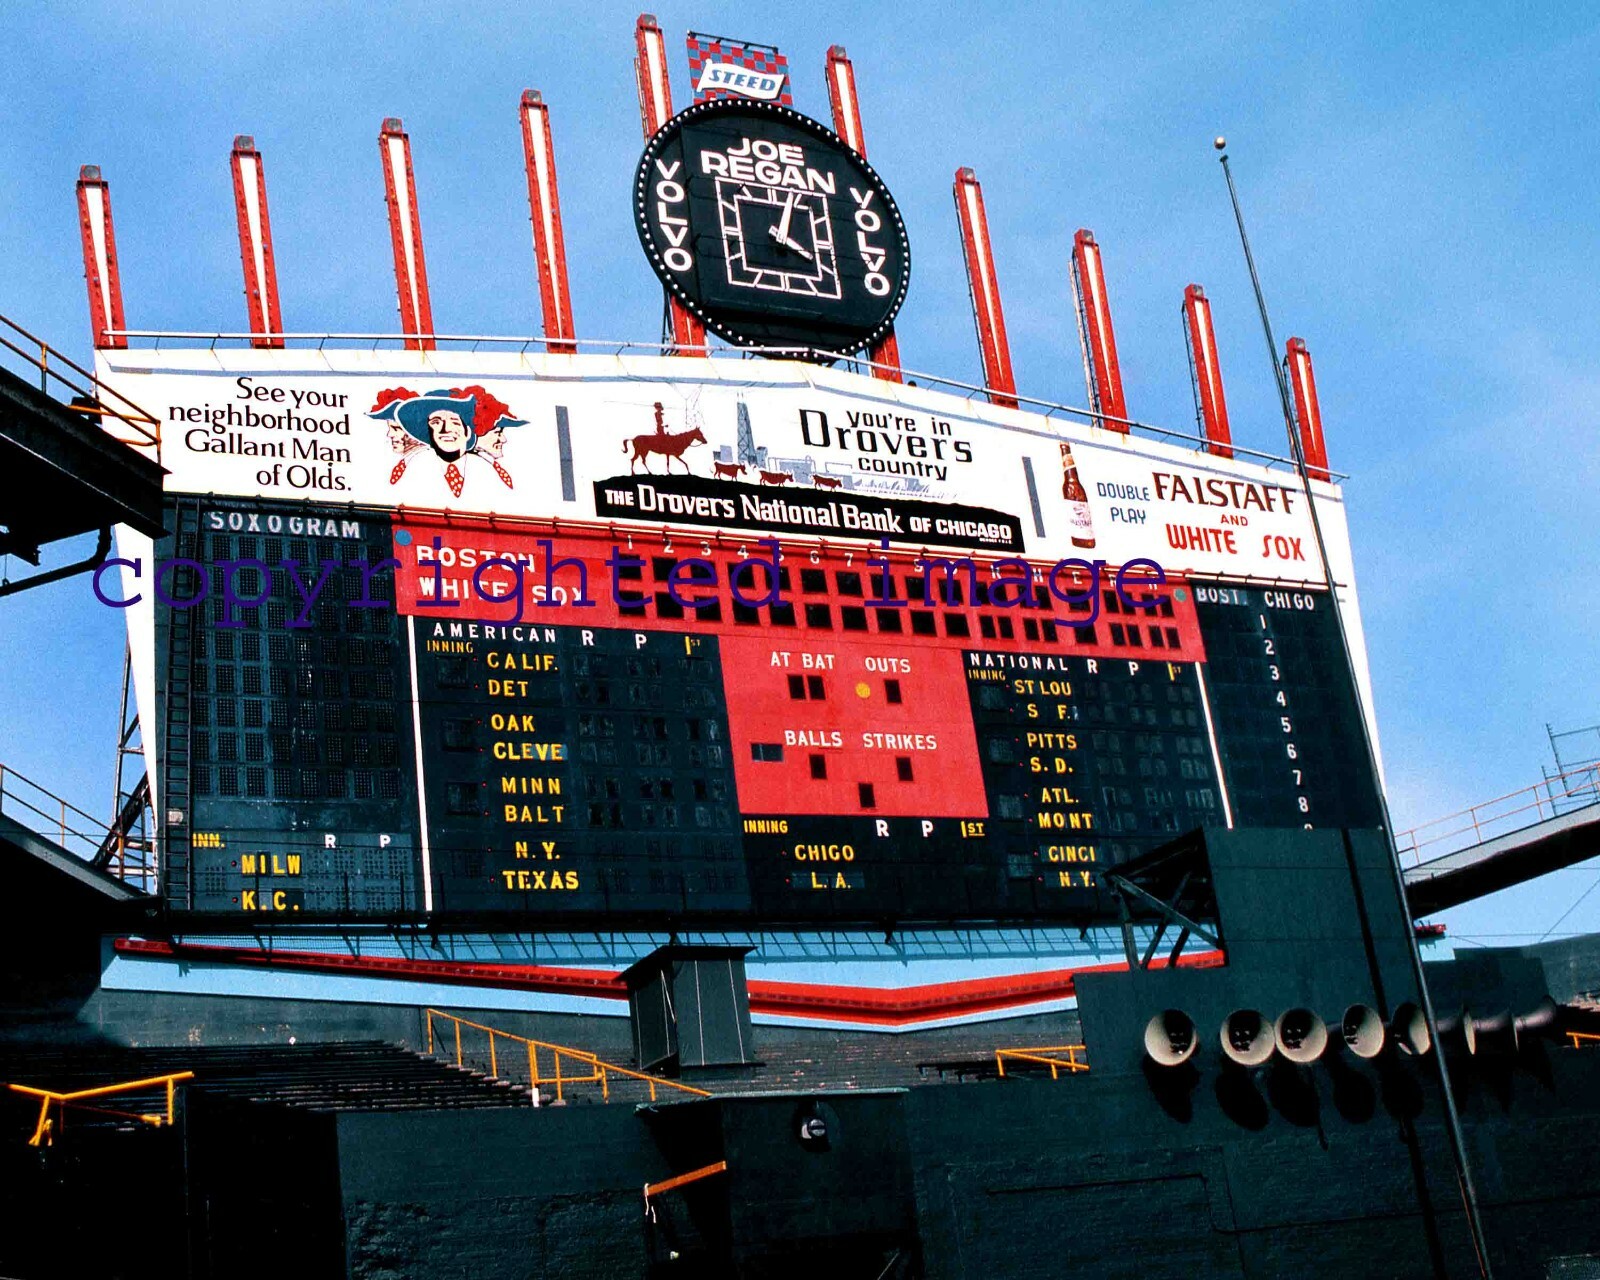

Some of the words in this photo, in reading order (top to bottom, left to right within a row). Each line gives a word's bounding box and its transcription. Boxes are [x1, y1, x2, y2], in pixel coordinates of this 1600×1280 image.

[708, 68, 776, 92] STEED
[727, 138, 805, 166] JOE
[701, 150, 836, 194] REGAN
[655, 159, 692, 271] VOLVO
[850, 187, 890, 296] VOLVO
[236, 377, 285, 402] See
[290, 389, 348, 409] your
[169, 403, 351, 435] neighborhood
[846, 411, 917, 432] you're
[931, 417, 952, 436] in
[799, 409, 973, 463] Drovers
[185, 429, 286, 458] Gallant
[292, 438, 351, 463] Man
[256, 464, 282, 486] of
[286, 463, 352, 491] Olds.
[858, 457, 948, 481] country
[1097, 482, 1150, 502] DOUBLE
[1152, 471, 1297, 514] FALSTAFF
[604, 489, 635, 506] THE
[637, 484, 736, 519] Drovers
[740, 493, 840, 528] National
[840, 504, 905, 533] Bank
[909, 516, 932, 533] OF
[936, 519, 1013, 540] CHICAGO
[1110, 507, 1147, 525] PLAY
[1220, 514, 1249, 527] AND
[1166, 524, 1238, 554] WHITE
[1262, 535, 1306, 562] SOX
[416, 545, 536, 573] BOSTON
[627, 534, 633, 550] 1
[663, 539, 674, 554] 2
[701, 541, 712, 556] 3
[737, 545, 749, 560] 4
[809, 550, 820, 565] 6
[844, 552, 854, 568] 7
[1033, 568, 1044, 583] H
[1260, 614, 1266, 629] 1
[433, 622, 556, 643] AMERICAN
[582, 630, 594, 646] R
[635, 633, 647, 649] P
[426, 639, 474, 653] INNING
[1264, 640, 1275, 655] 2
[487, 652, 559, 671] CALIF.
[770, 651, 791, 667] AT
[802, 653, 835, 670] BAT
[864, 657, 911, 673] OUTS
[970, 652, 1069, 672] NATIONAL
[1087, 659, 1098, 674] R
[1129, 661, 1139, 676] P
[968, 669, 1006, 681] INNING
[1269, 665, 1280, 680] 3
[488, 679, 529, 697] DET
[1014, 680, 1035, 695] ST
[1040, 681, 1072, 696] LOU
[1276, 691, 1287, 707] 4
[491, 714, 535, 732] OAK
[1281, 717, 1292, 733] 5
[784, 730, 843, 747] BALLS
[862, 733, 937, 750] STRIKES
[1026, 732, 1077, 749] PITTS
[493, 742, 564, 761] CLEVE
[1286, 743, 1297, 759] 6
[501, 776, 561, 795] MINN
[1292, 770, 1302, 785] 7
[1041, 788, 1080, 803] ATL.
[1298, 796, 1309, 812] 8
[504, 804, 565, 823] BALT
[1037, 812, 1092, 829] MONT
[743, 820, 788, 834] INNING
[875, 819, 889, 837] R
[921, 820, 934, 837] P
[192, 833, 225, 848] INN.
[324, 834, 336, 848] R
[379, 834, 391, 848] P
[794, 844, 855, 861] CHIGO
[1048, 846, 1096, 862] CINCI
[241, 854, 301, 875] MILW
[502, 870, 580, 890] TEXAS
